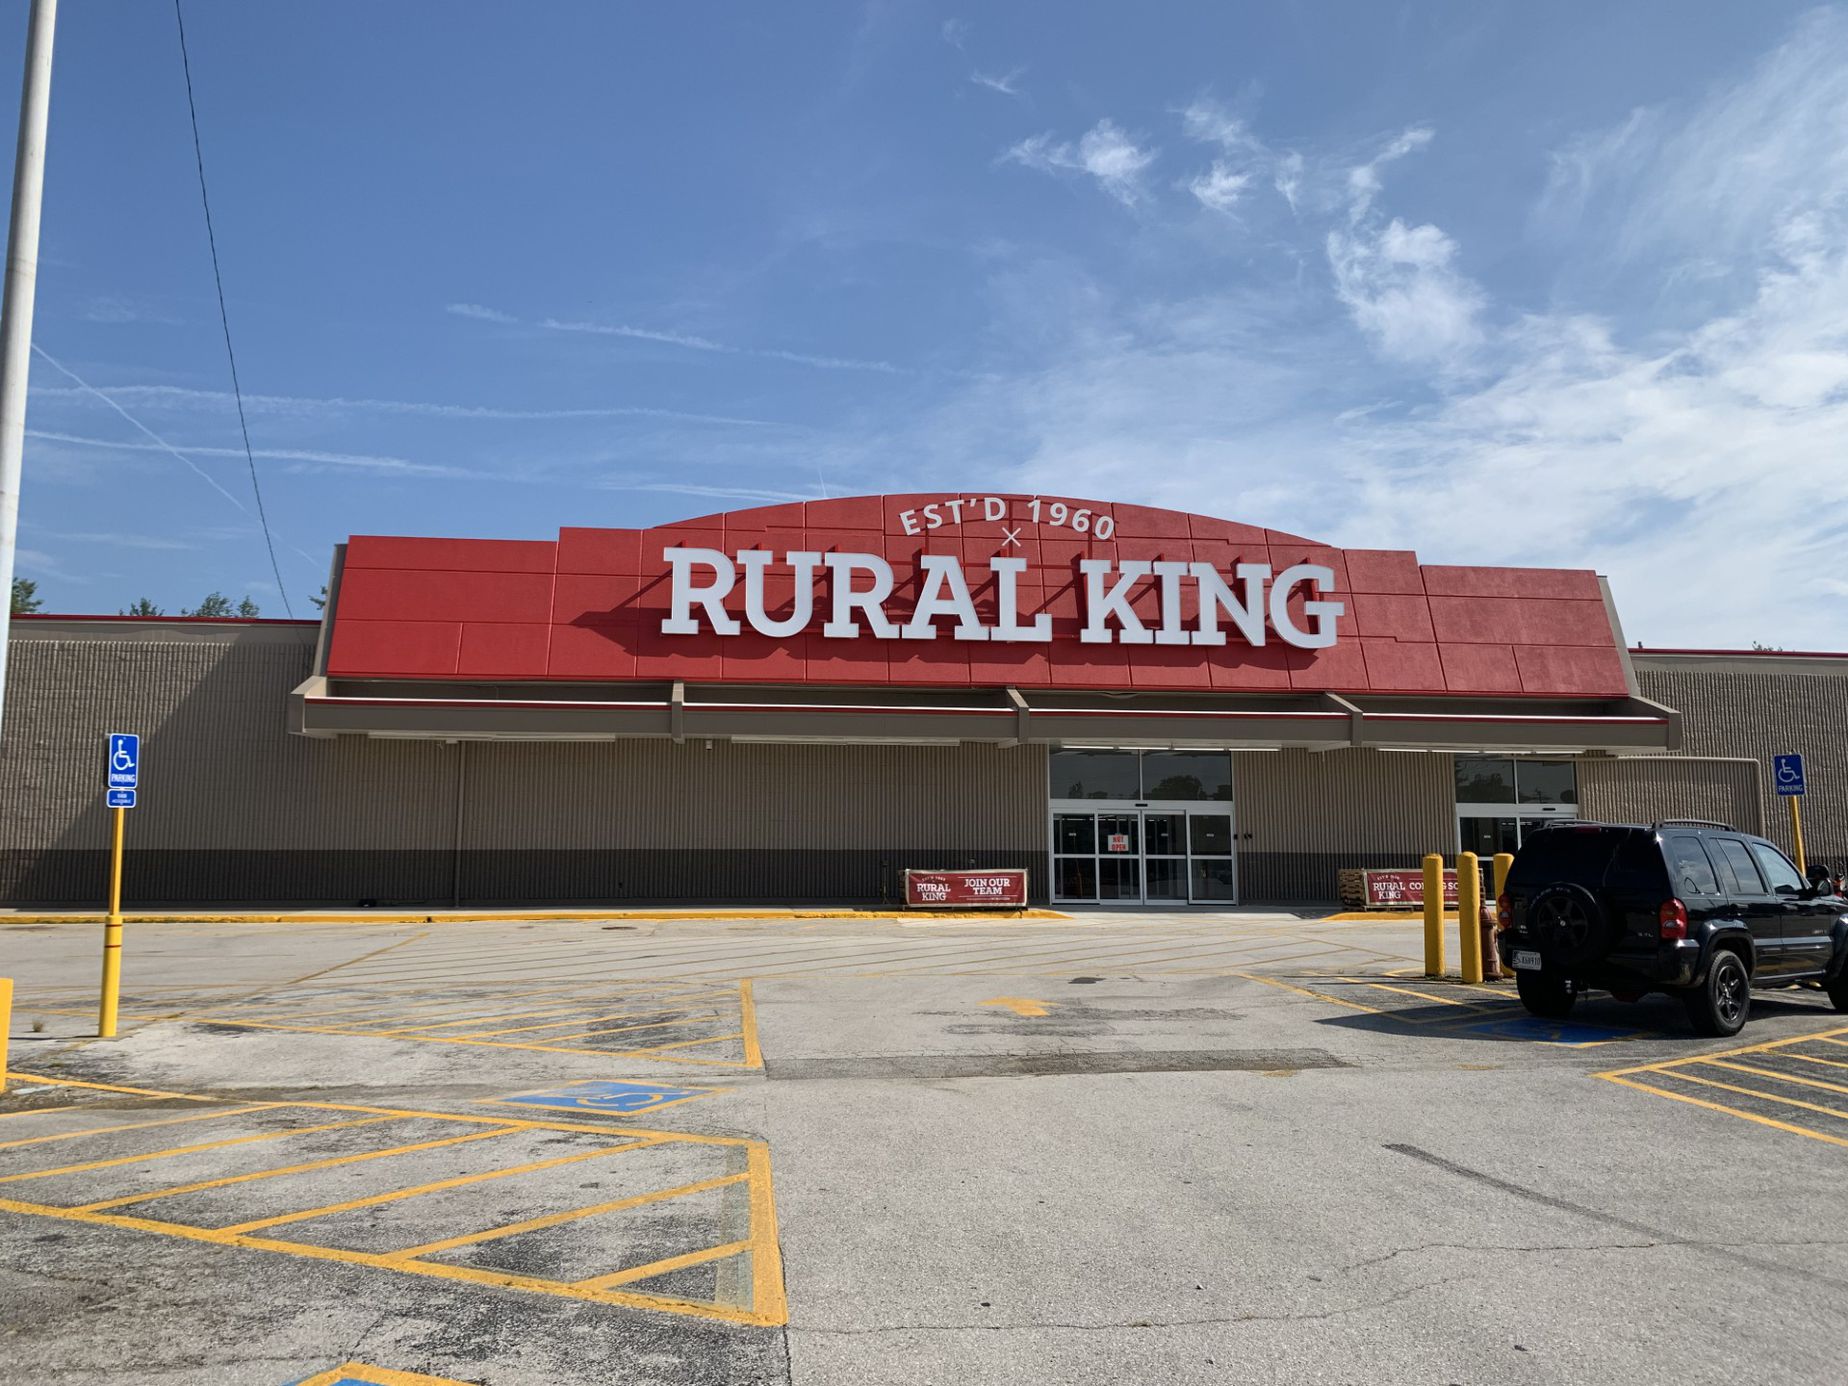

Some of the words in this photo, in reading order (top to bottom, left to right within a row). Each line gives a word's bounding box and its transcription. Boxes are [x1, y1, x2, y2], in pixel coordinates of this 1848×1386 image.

[899, 497, 1006, 536] EST'D
[1027, 500, 1115, 540] 1960
[661, 547, 1052, 642] RURAL
[1080, 559, 1345, 649] KING
[111, 773, 135, 783] PARKING
[964, 878, 987, 887] JOIN
[988, 878, 1010, 887] OUR
[1373, 882, 1405, 891] RURAL
[916, 883, 951, 892] RURAL
[972, 887, 1002, 895] TEAM
[922, 892, 946, 901] KING
[1378, 891, 1401, 900] KING
